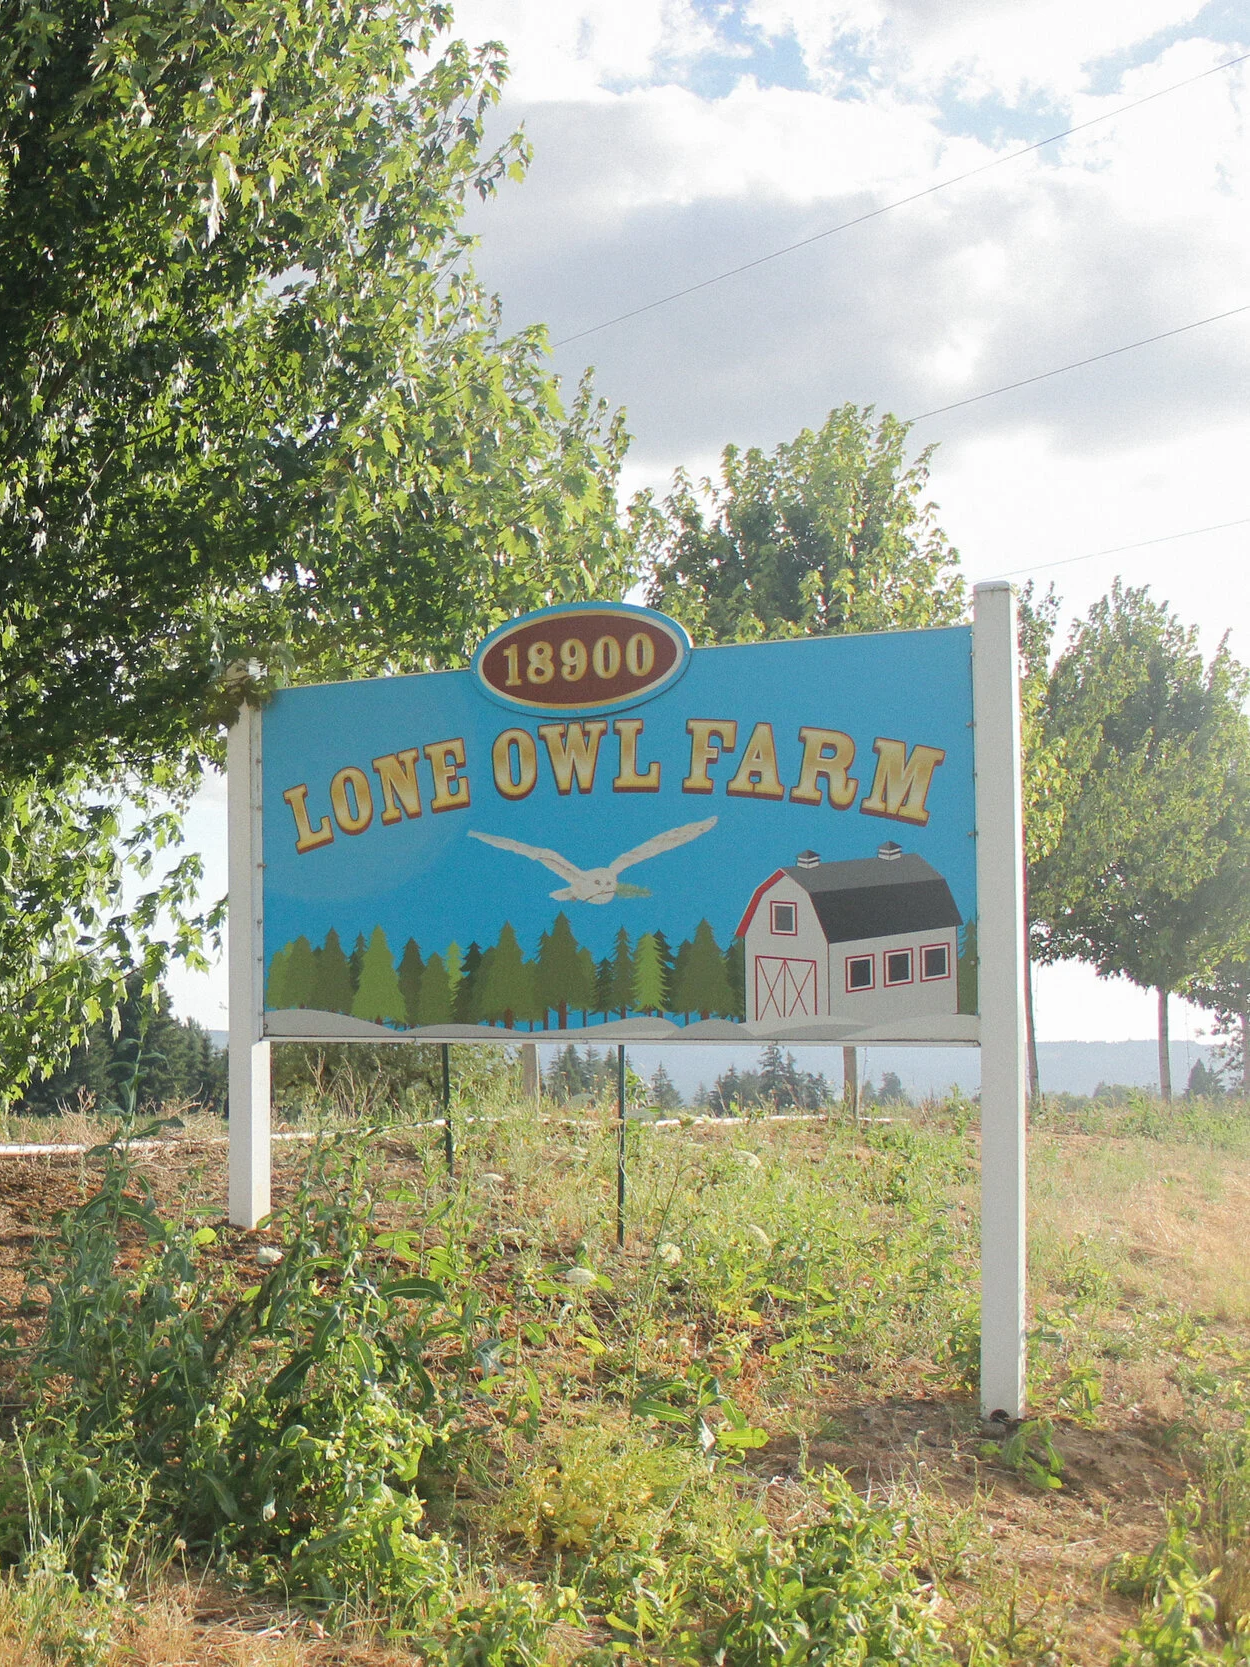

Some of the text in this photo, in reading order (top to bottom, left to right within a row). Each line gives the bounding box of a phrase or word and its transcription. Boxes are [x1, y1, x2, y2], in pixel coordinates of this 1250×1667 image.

[502, 632, 656, 687] 18900
[282, 717, 945, 854] LONE OWL FARM
